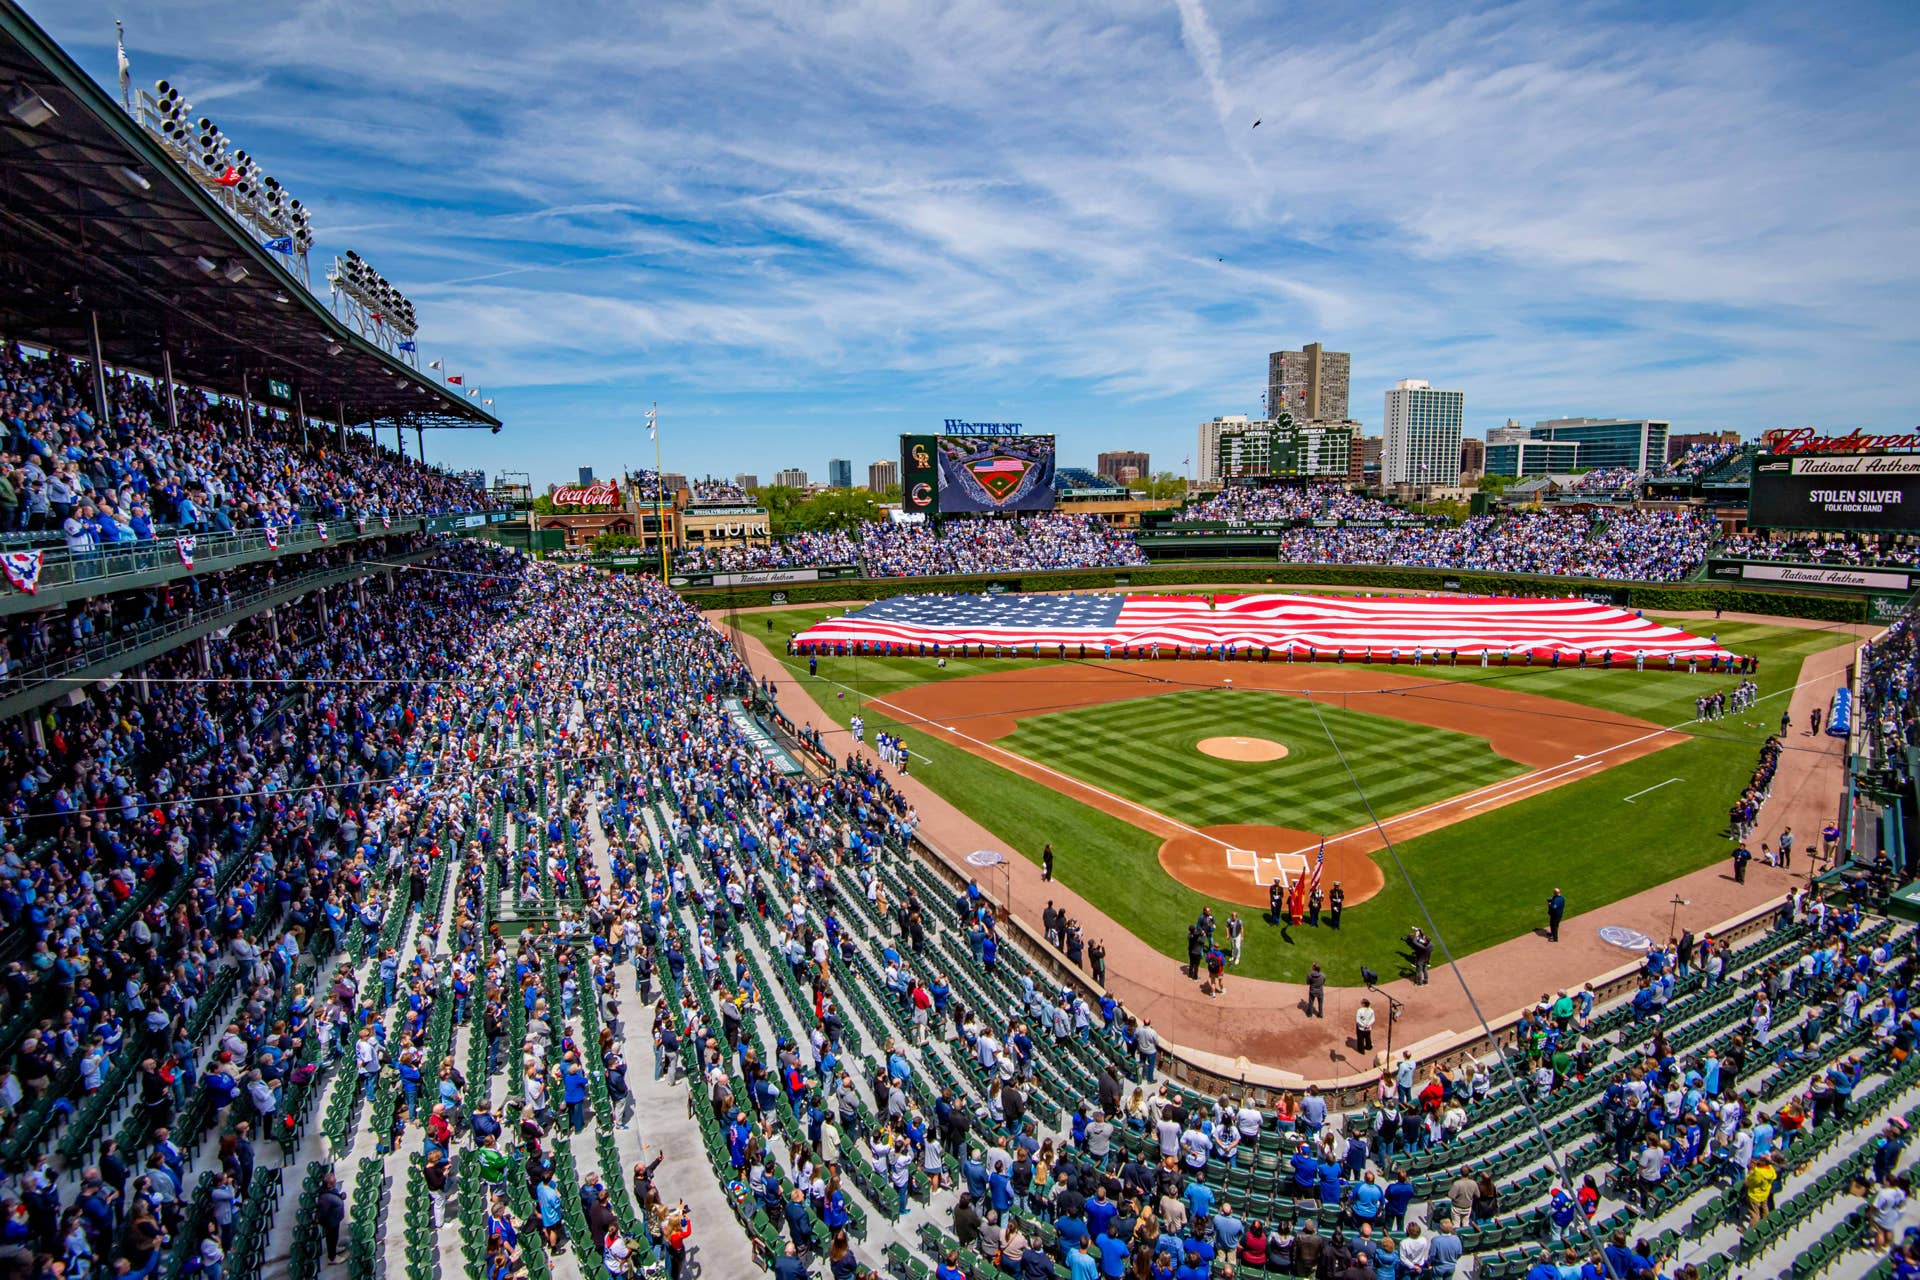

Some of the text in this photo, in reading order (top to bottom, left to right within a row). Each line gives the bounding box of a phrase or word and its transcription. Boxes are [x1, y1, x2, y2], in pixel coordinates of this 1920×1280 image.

[944, 419, 1022, 435] WINTRUST
[1799, 458, 1920, 473] National Anthem
[552, 485, 616, 506] Coca-Cola
[1809, 490, 1903, 504] STOLEN SILVER
[1824, 503, 1883, 513] FOLK ROCK BAND
[741, 573, 794, 582] National Anthem
[1781, 569, 1865, 584] National Anthem
